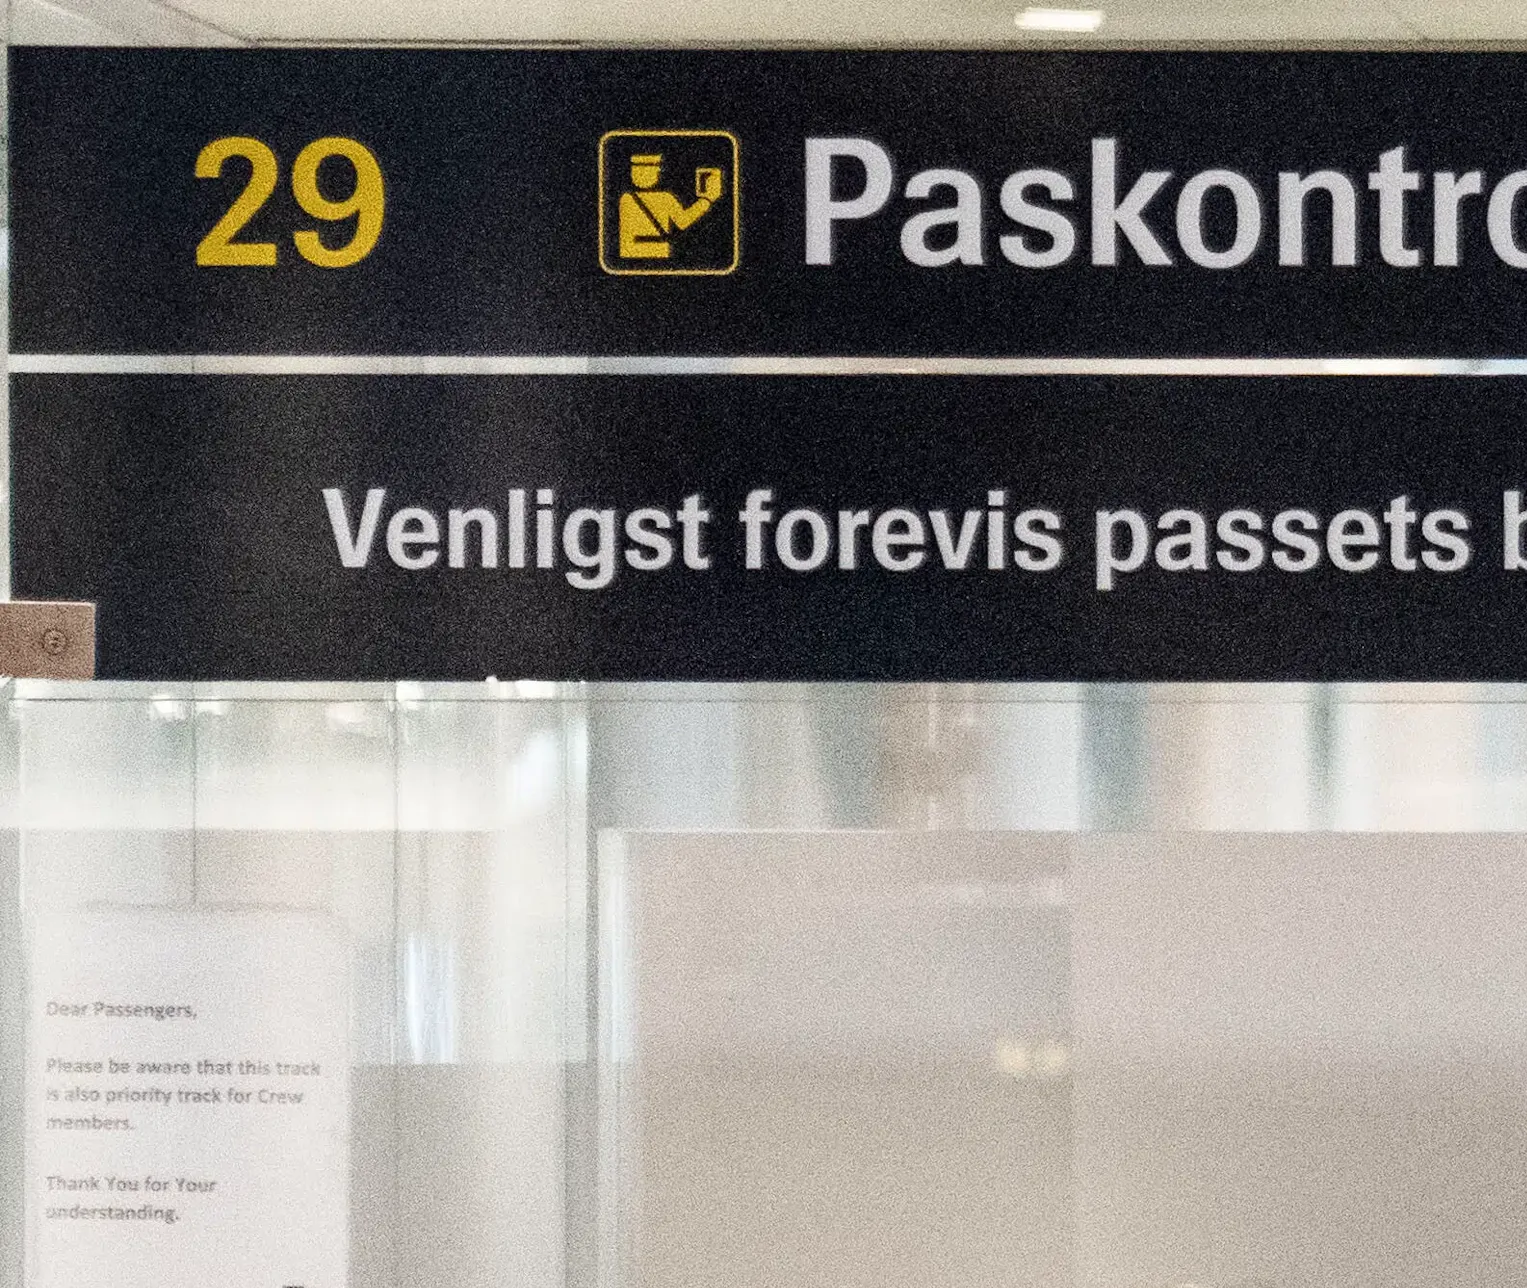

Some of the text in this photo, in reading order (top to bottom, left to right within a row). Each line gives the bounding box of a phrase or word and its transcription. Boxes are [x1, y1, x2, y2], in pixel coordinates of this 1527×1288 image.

[196, 137, 385, 268] 29
[323, 487, 709, 589] Venligst
[740, 490, 1062, 571] forevis
[1096, 496, 1470, 590] passets
[46, 1001, 197, 1021] Dear Passengers,
[46, 1057, 320, 1076] Please be aware that this track
[46, 1086, 303, 1106] is also priority track for Crew
[46, 1114, 135, 1130] members.
[46, 1176, 217, 1192] Thank You for Your
[46, 1204, 180, 1224] understanding.
